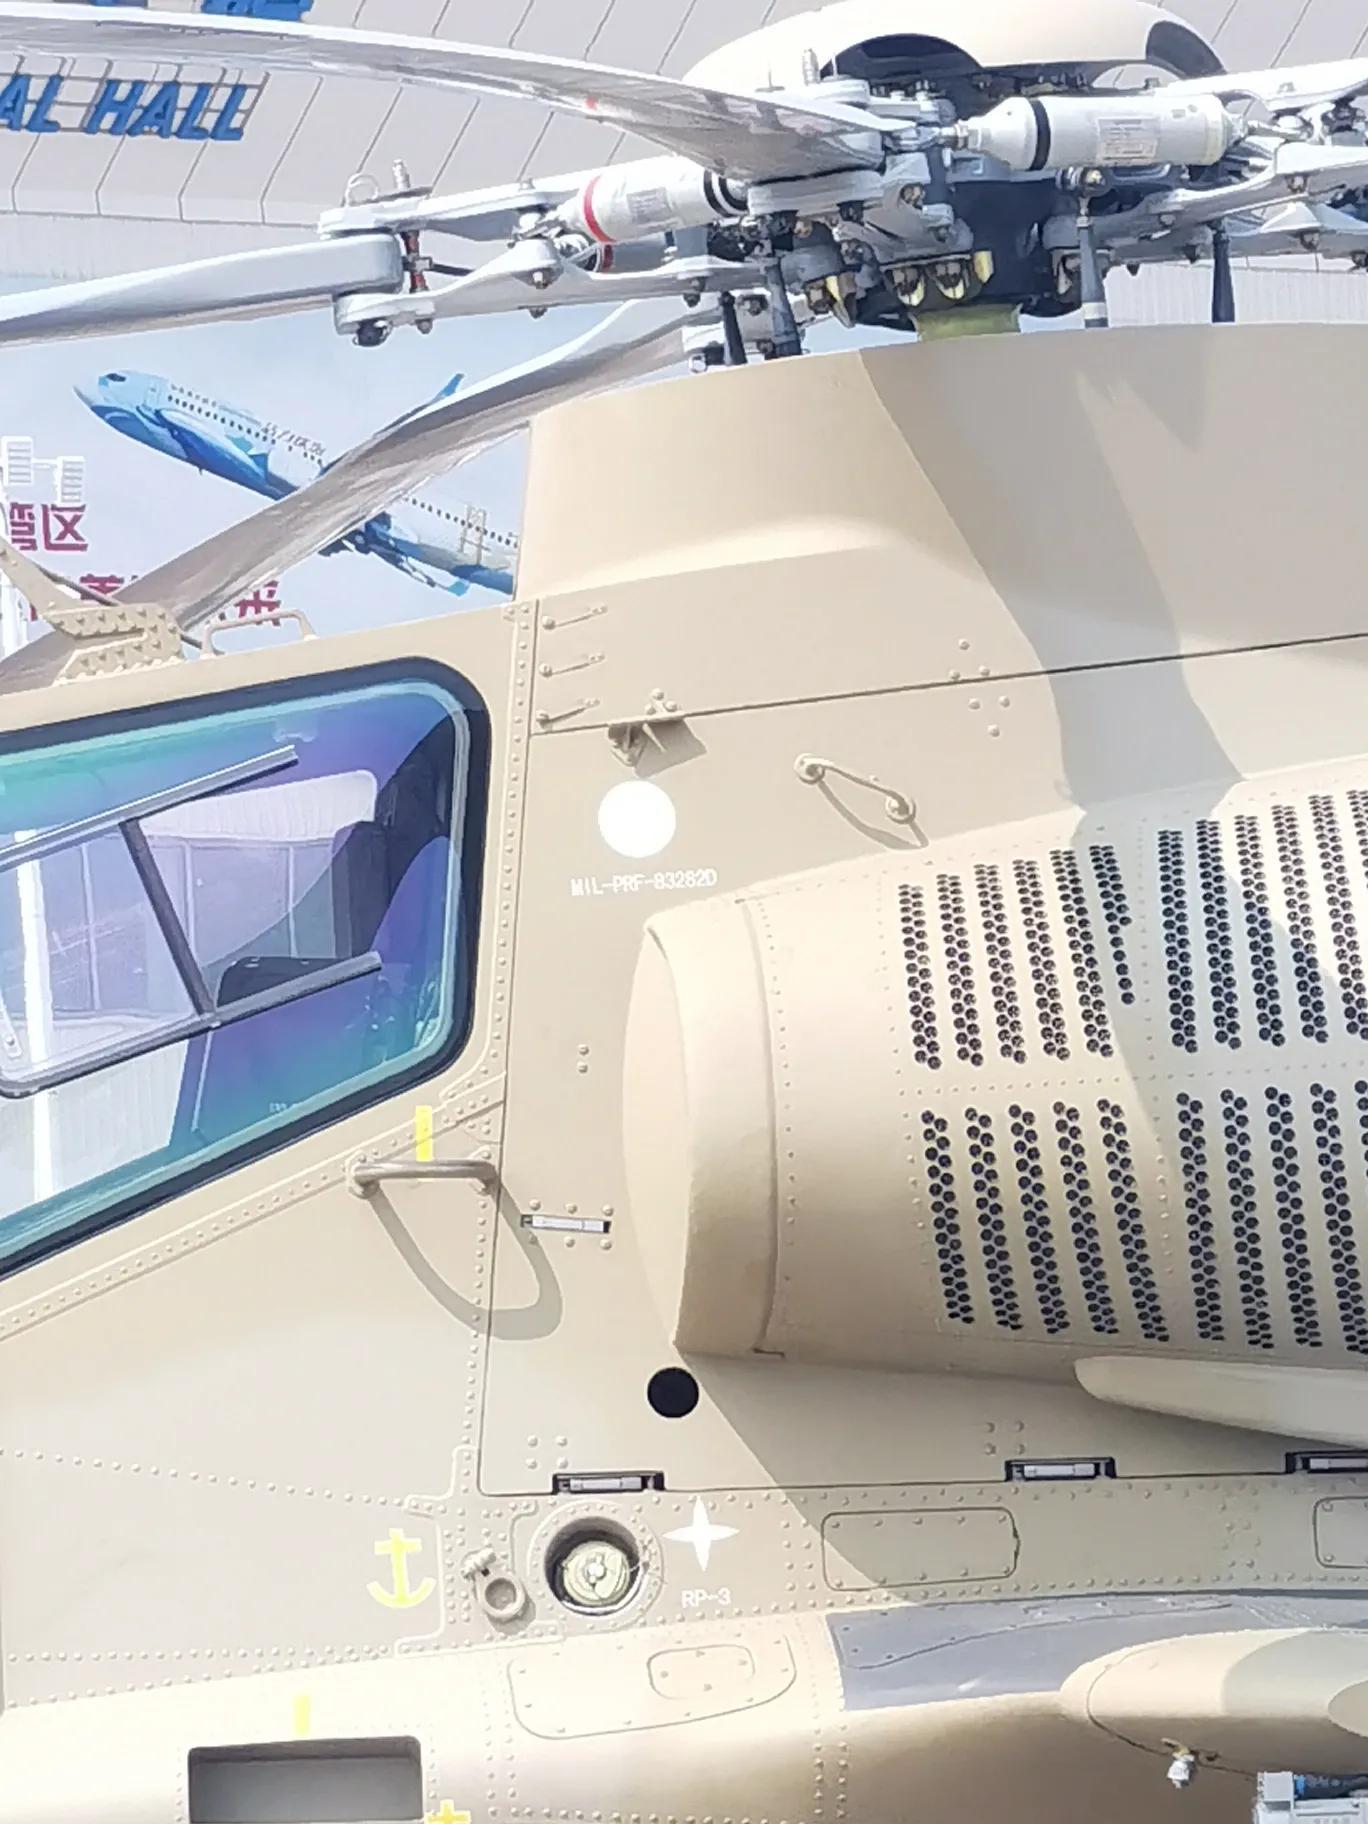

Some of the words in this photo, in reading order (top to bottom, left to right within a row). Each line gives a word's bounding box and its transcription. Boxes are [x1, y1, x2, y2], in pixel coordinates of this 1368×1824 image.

[82, 79, 246, 141] HALL
[569, 867, 718, 897] MIL-PRF-83282D
[681, 1587, 732, 1609] RP-3
